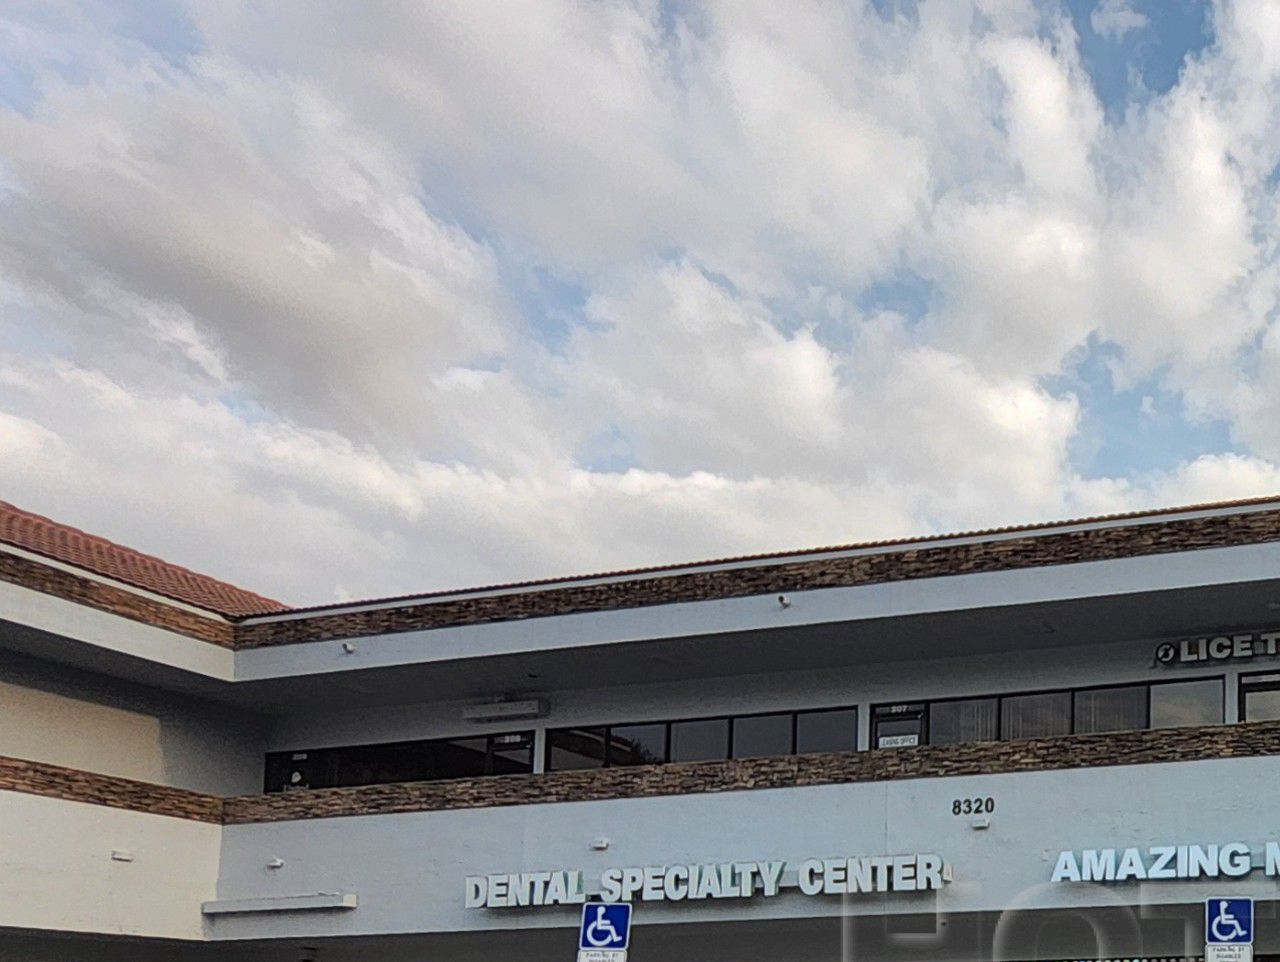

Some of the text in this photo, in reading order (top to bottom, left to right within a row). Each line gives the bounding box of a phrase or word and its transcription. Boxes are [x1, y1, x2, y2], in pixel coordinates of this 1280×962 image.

[1180, 633, 1254, 663] LICE
[952, 797, 994, 816] 8320
[1051, 842, 1252, 883] AMAZING
[464, 853, 945, 909] DENTAL SPECIALTY CENTER
